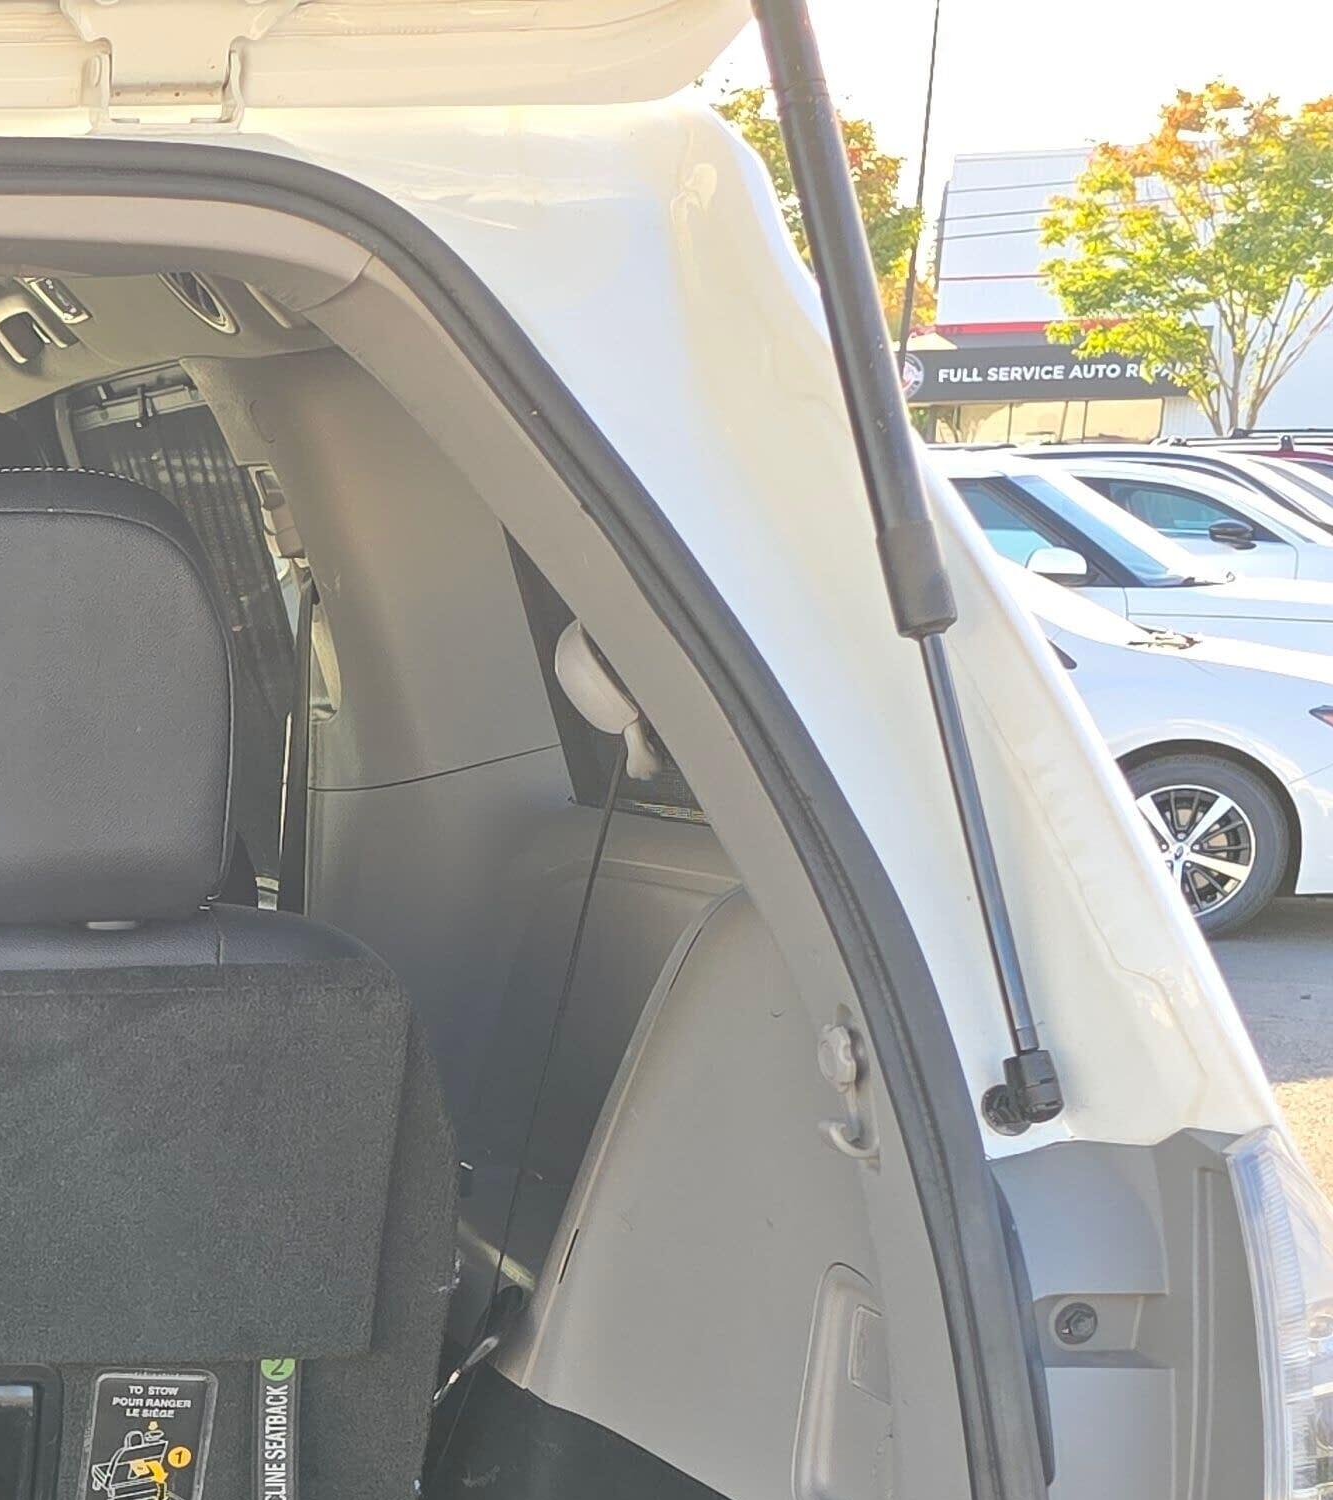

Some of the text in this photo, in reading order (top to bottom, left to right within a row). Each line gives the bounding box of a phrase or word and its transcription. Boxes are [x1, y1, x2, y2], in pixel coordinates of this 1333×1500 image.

[938, 368, 982, 383] FULL
[987, 365, 1065, 381] SERVICE
[1069, 364, 1121, 380] AUTO
[129, 1385, 179, 1396] TO STOW
[112, 1397, 191, 1408] POUR RANGER
[126, 1408, 140, 1417] LE
[265, 1384, 288, 1459] SEATBACK
